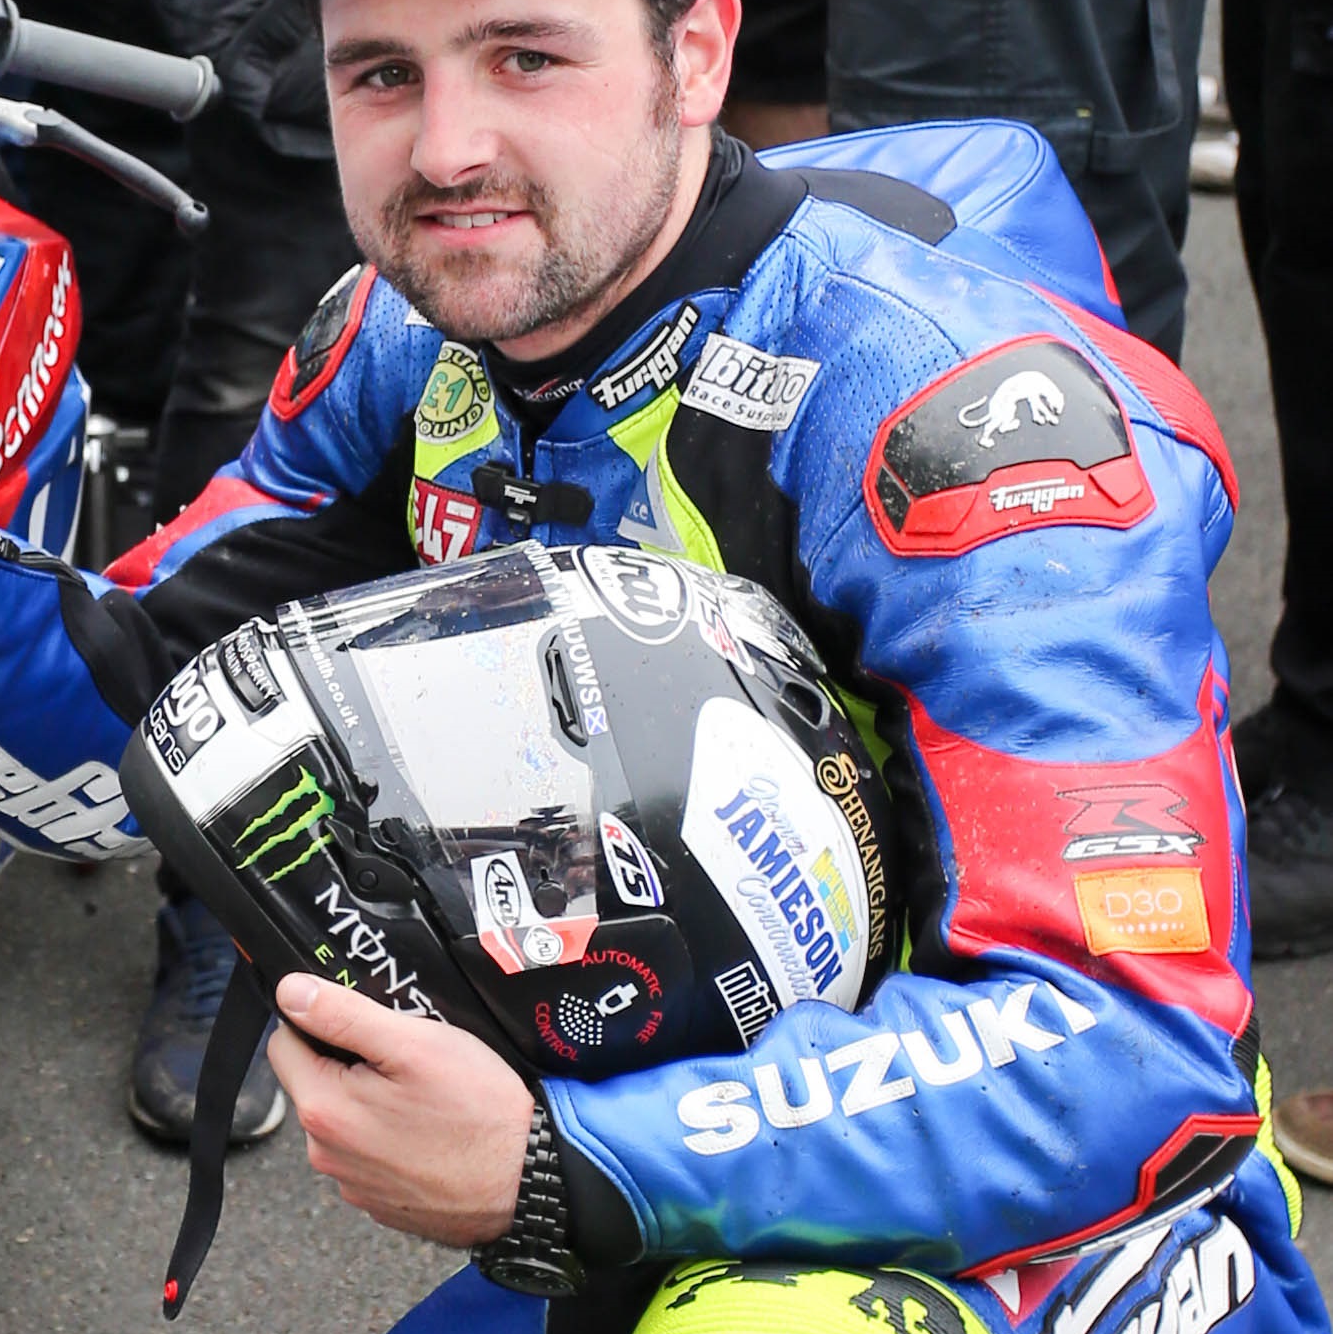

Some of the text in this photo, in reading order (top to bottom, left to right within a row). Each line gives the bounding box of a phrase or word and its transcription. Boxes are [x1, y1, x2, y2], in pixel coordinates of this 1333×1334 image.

[424, 371, 468, 413] £1
[438, 347, 490, 402] OUND
[590, 304, 699, 409] Furygan
[689, 385, 732, 410] Race
[416, 403, 483, 438] OUND
[989, 477, 1084, 514] Furygan
[817, 751, 887, 960] SHENANIGANS
[1063, 834, 1204, 859] GSX
[493, 868, 519, 928] Arai
[714, 789, 844, 997] JAMIESON
[315, 881, 449, 1022] MONS
[736, 874, 814, 1001] Constructio
[534, 950, 664, 1062] AUTOMATIC FIRE CONTROL
[677, 997, 1098, 1156] SUZUKI
